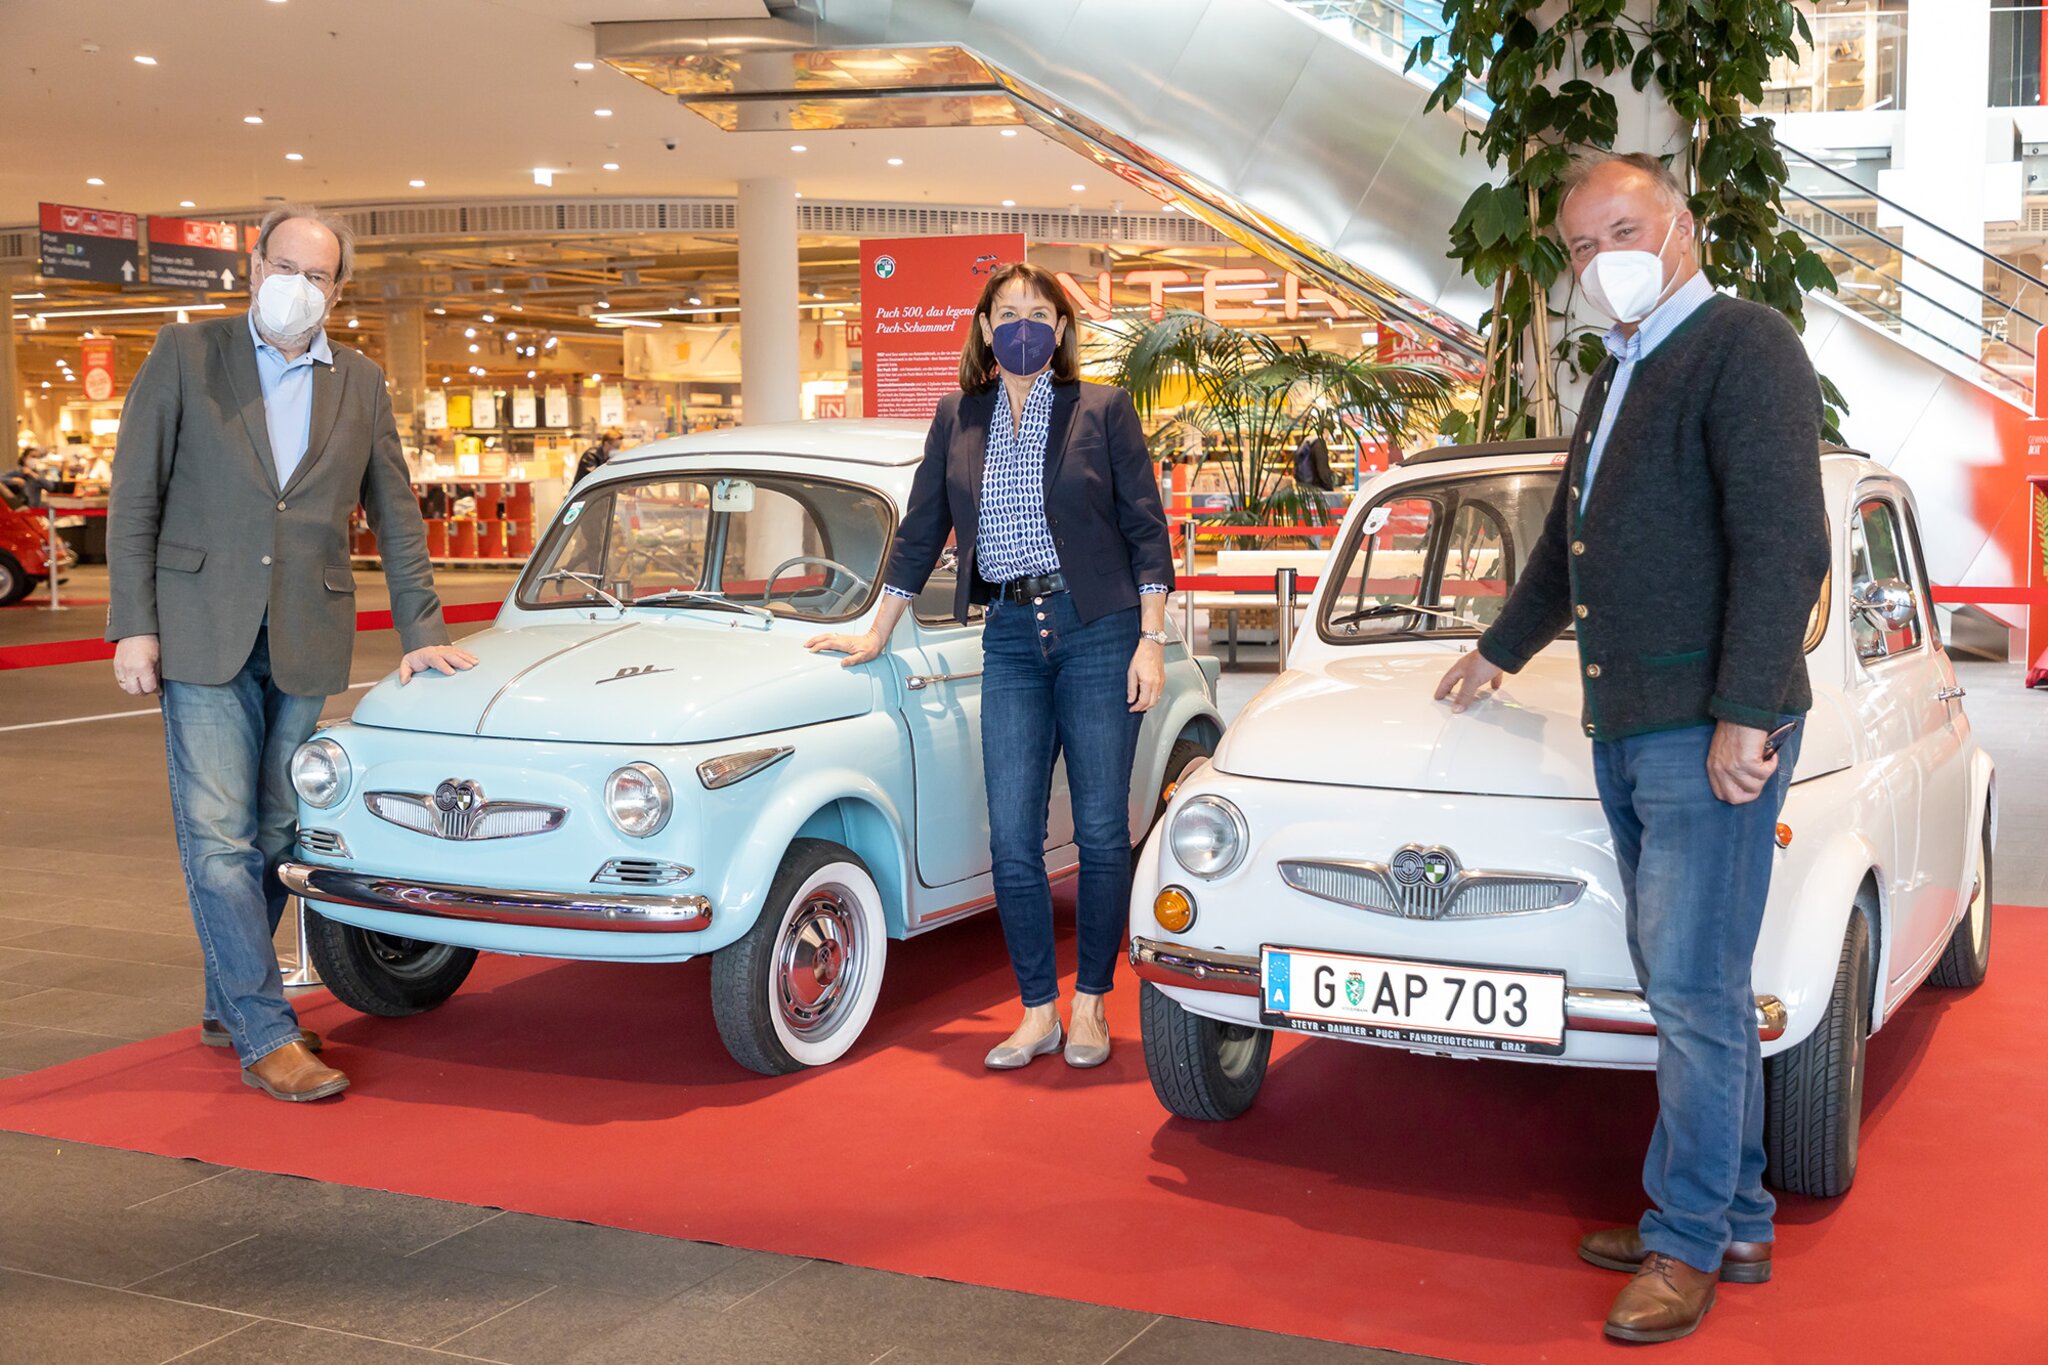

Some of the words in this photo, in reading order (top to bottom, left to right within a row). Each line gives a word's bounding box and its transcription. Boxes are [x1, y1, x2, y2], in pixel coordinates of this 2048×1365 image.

[876, 307, 900, 319] Puch
[902, 306, 924, 318] 500,
[926, 305, 944, 317] das
[875, 320, 956, 334] Puch-Schammerl
[1273, 988, 1286, 1004] A
[1314, 965, 1336, 1009] G
[1371, 970, 1428, 1017] AP
[1443, 976, 1528, 1028] 703
[1290, 1019, 1319, 1031] STEYR
[1327, 1023, 1367, 1036] DAIMLER
[1375, 1030, 1400, 1040] PUCH
[1501, 1042, 1527, 1053] GRAZ
